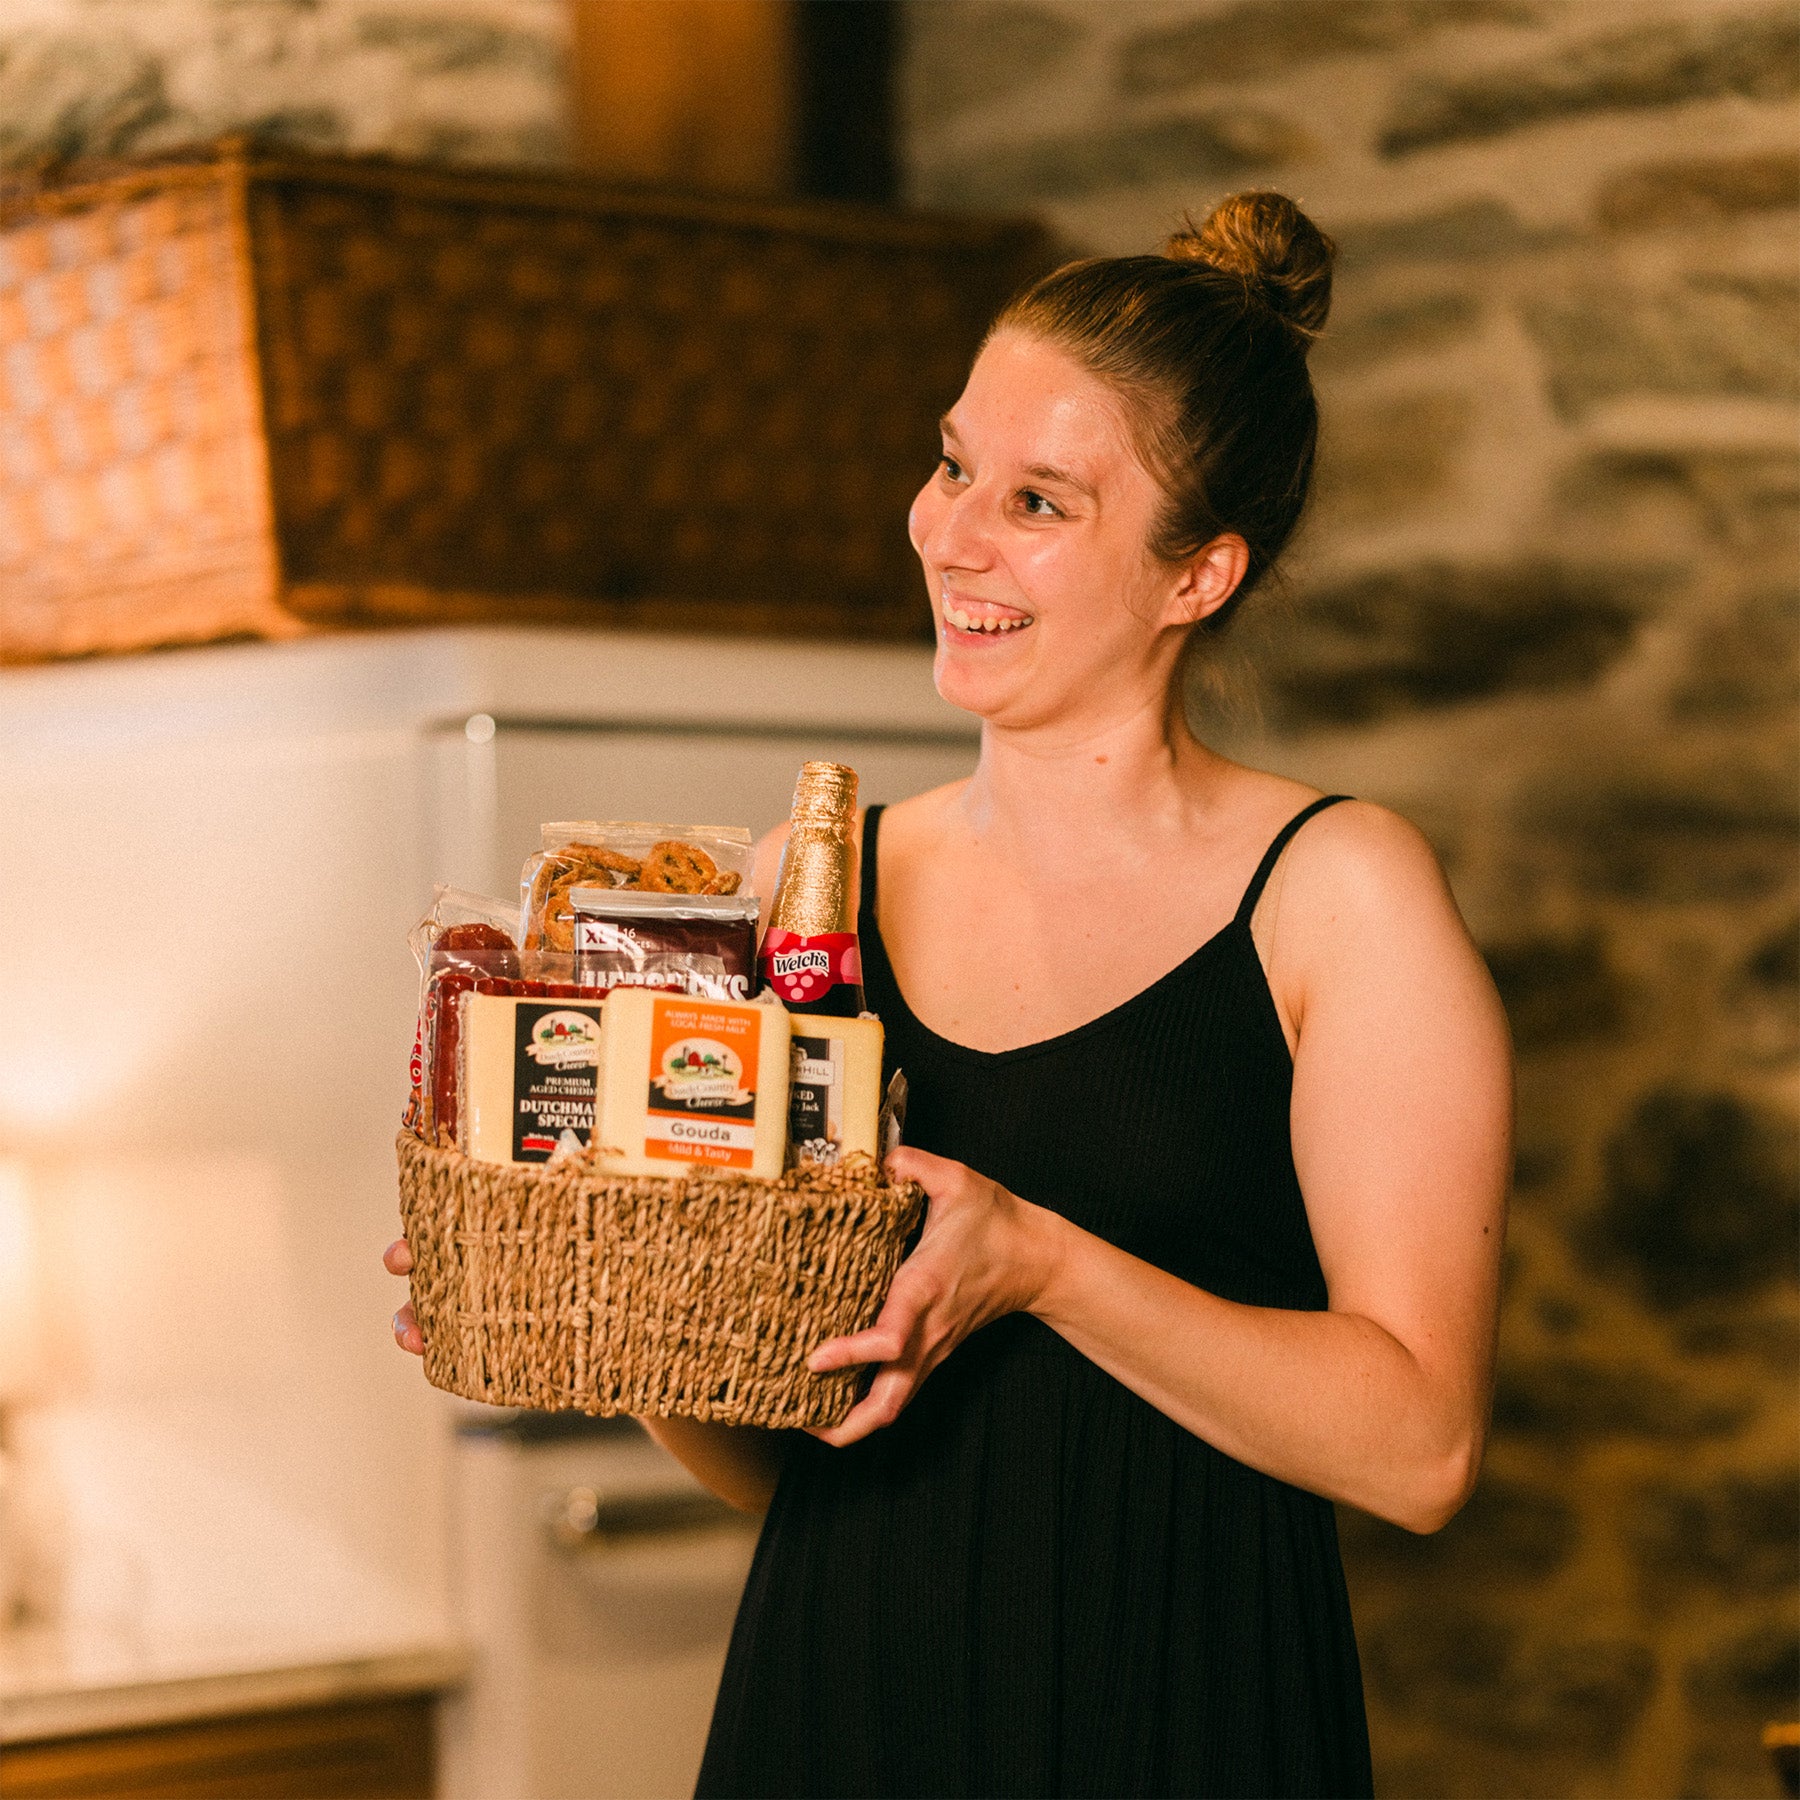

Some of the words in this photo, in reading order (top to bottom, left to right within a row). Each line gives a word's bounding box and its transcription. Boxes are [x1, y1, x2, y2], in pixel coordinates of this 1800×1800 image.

[623, 927, 636, 939] 16
[775, 951, 828, 974] Welch's
[664, 1009, 698, 1020] ALWAYS
[701, 1013, 726, 1023] MADE
[728, 1017, 751, 1027] WITH
[670, 1018, 697, 1029] LOCAL
[699, 1021, 725, 1032] FRESH
[726, 1025, 746, 1034] MILK
[530, 1085, 558, 1095] AGED
[544, 1076, 591, 1088] PREMIUM
[671, 1122, 731, 1141] Gouda
[668, 1142, 692, 1156] Mild
[694, 1147, 703, 1157] &
[704, 1146, 732, 1162] Tasty
